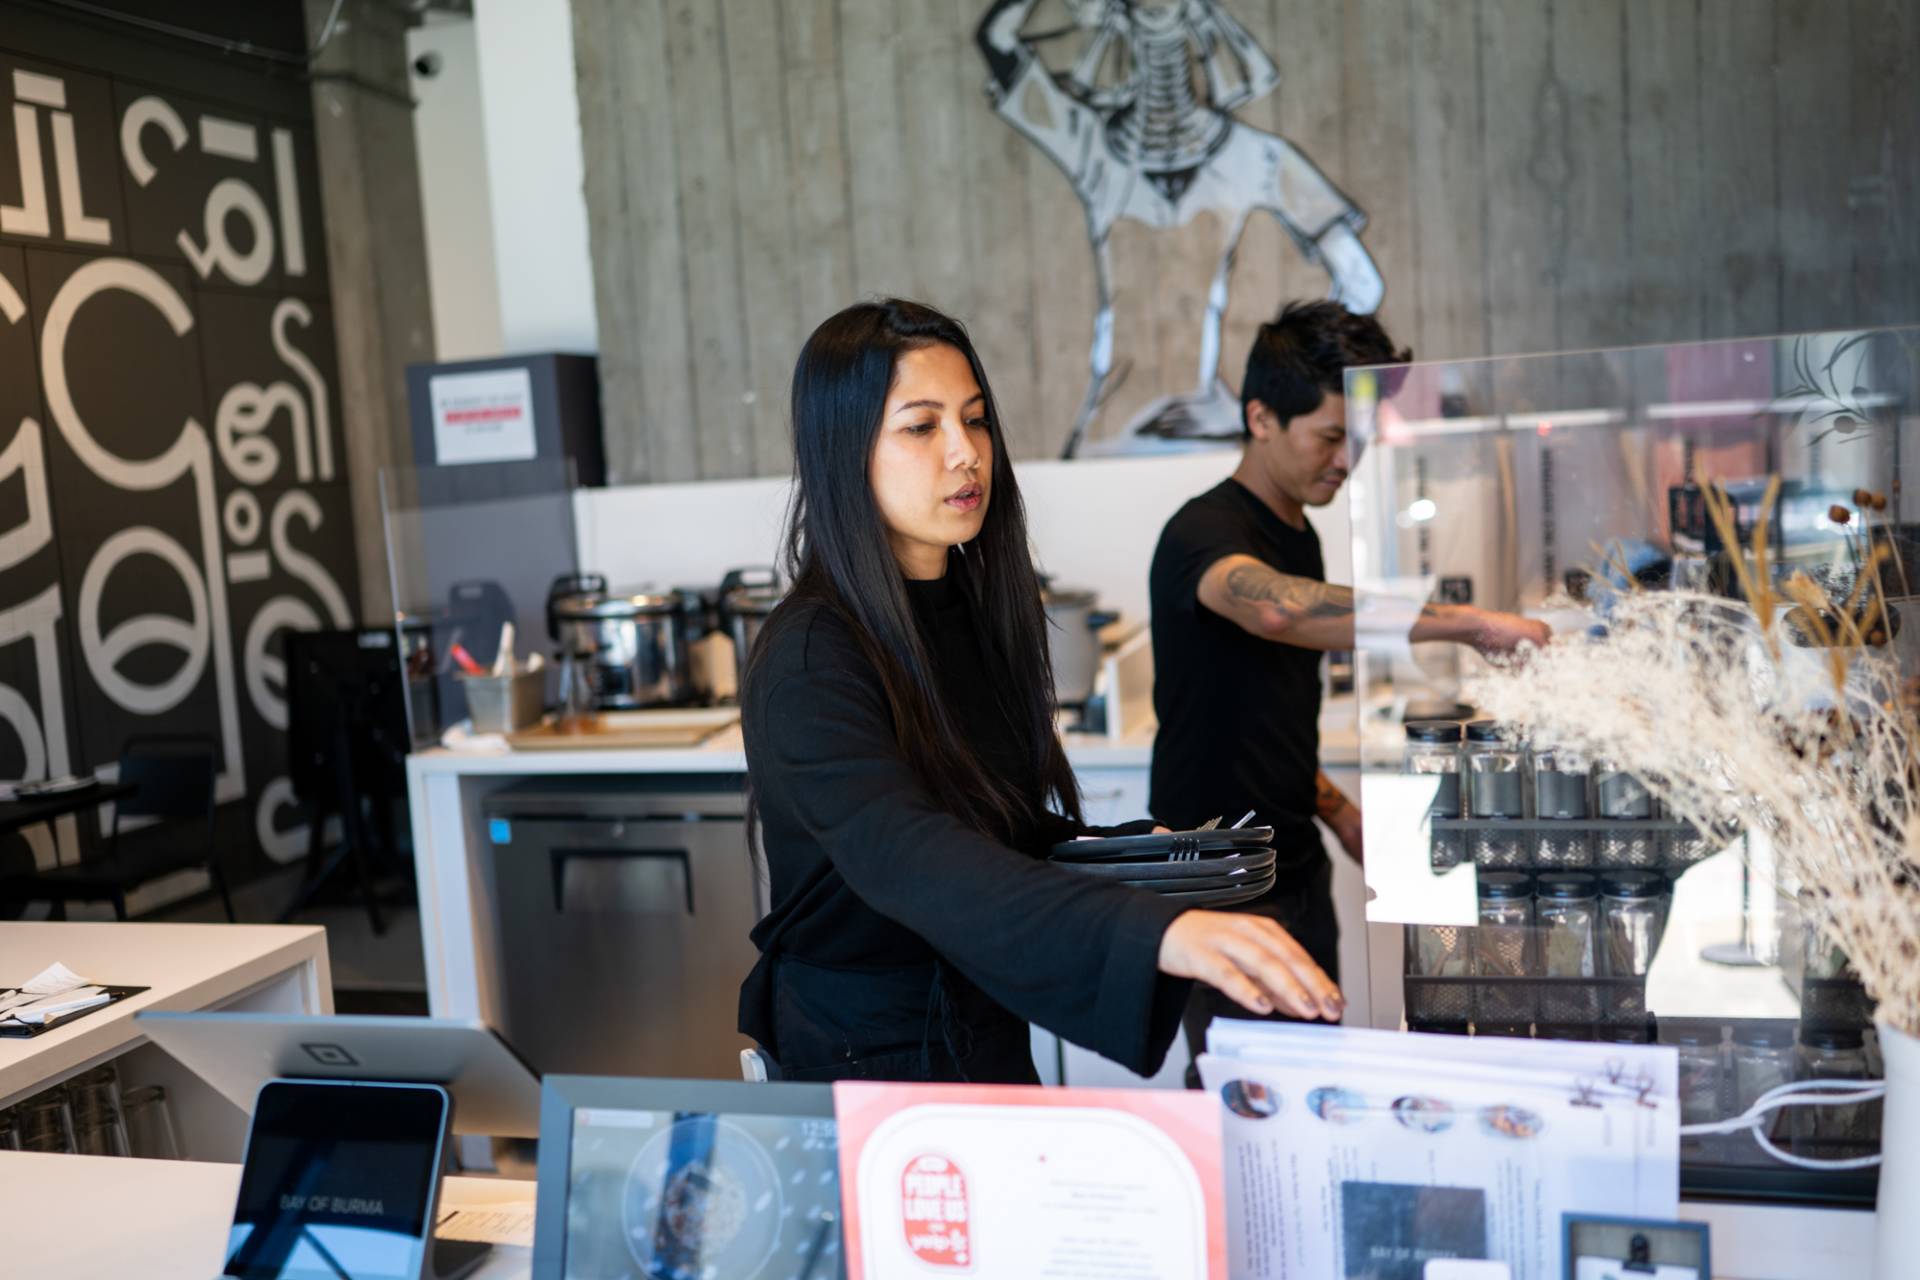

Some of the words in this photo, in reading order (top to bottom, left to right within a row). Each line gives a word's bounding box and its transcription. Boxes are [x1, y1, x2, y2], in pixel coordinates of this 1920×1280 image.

[905, 1174, 963, 1197] PEOPLE
[307, 1195, 330, 1212] OF
[331, 1197, 384, 1215] BURMA
[905, 1198, 943, 1222] LOVE
[946, 1199, 967, 1223] US
